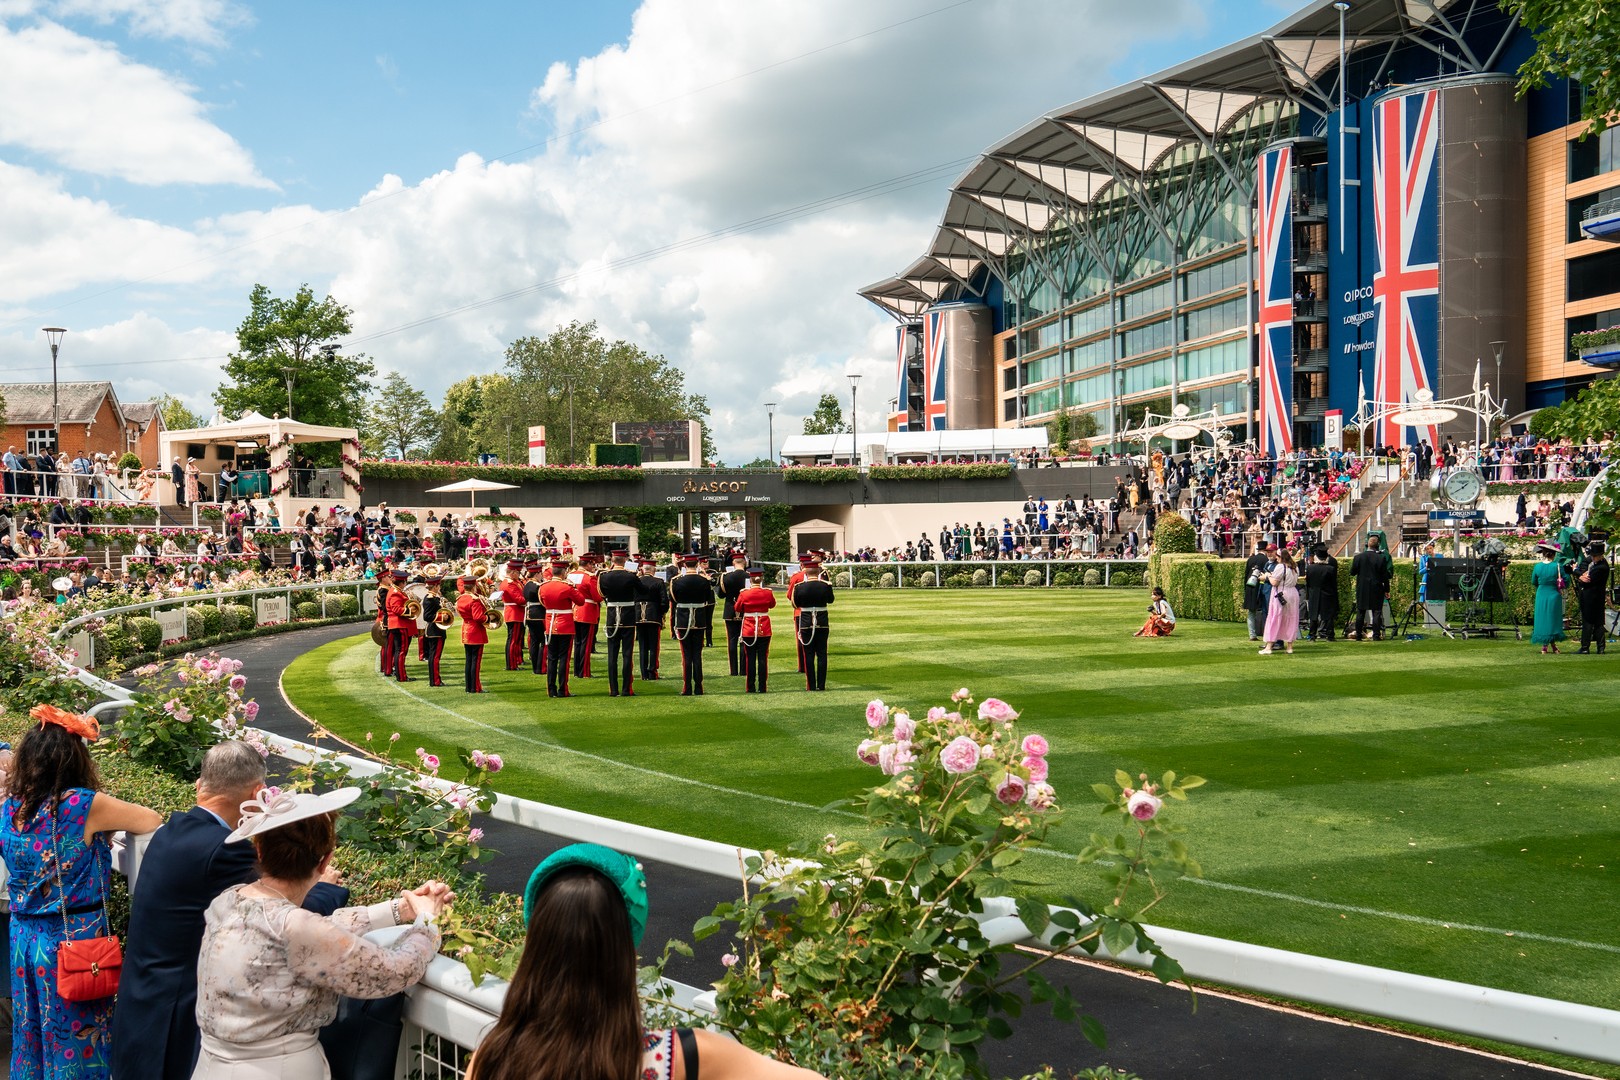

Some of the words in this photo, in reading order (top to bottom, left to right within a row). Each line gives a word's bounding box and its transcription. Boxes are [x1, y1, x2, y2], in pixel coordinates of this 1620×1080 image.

[1344, 286, 1374, 302] QIPCO
[1343, 310, 1374, 325] LONGINES
[1352, 340, 1374, 352] howden
[1328, 419, 1335, 433] B
[700, 481, 748, 493] ASCOT
[264, 602, 280, 611] PERONI
